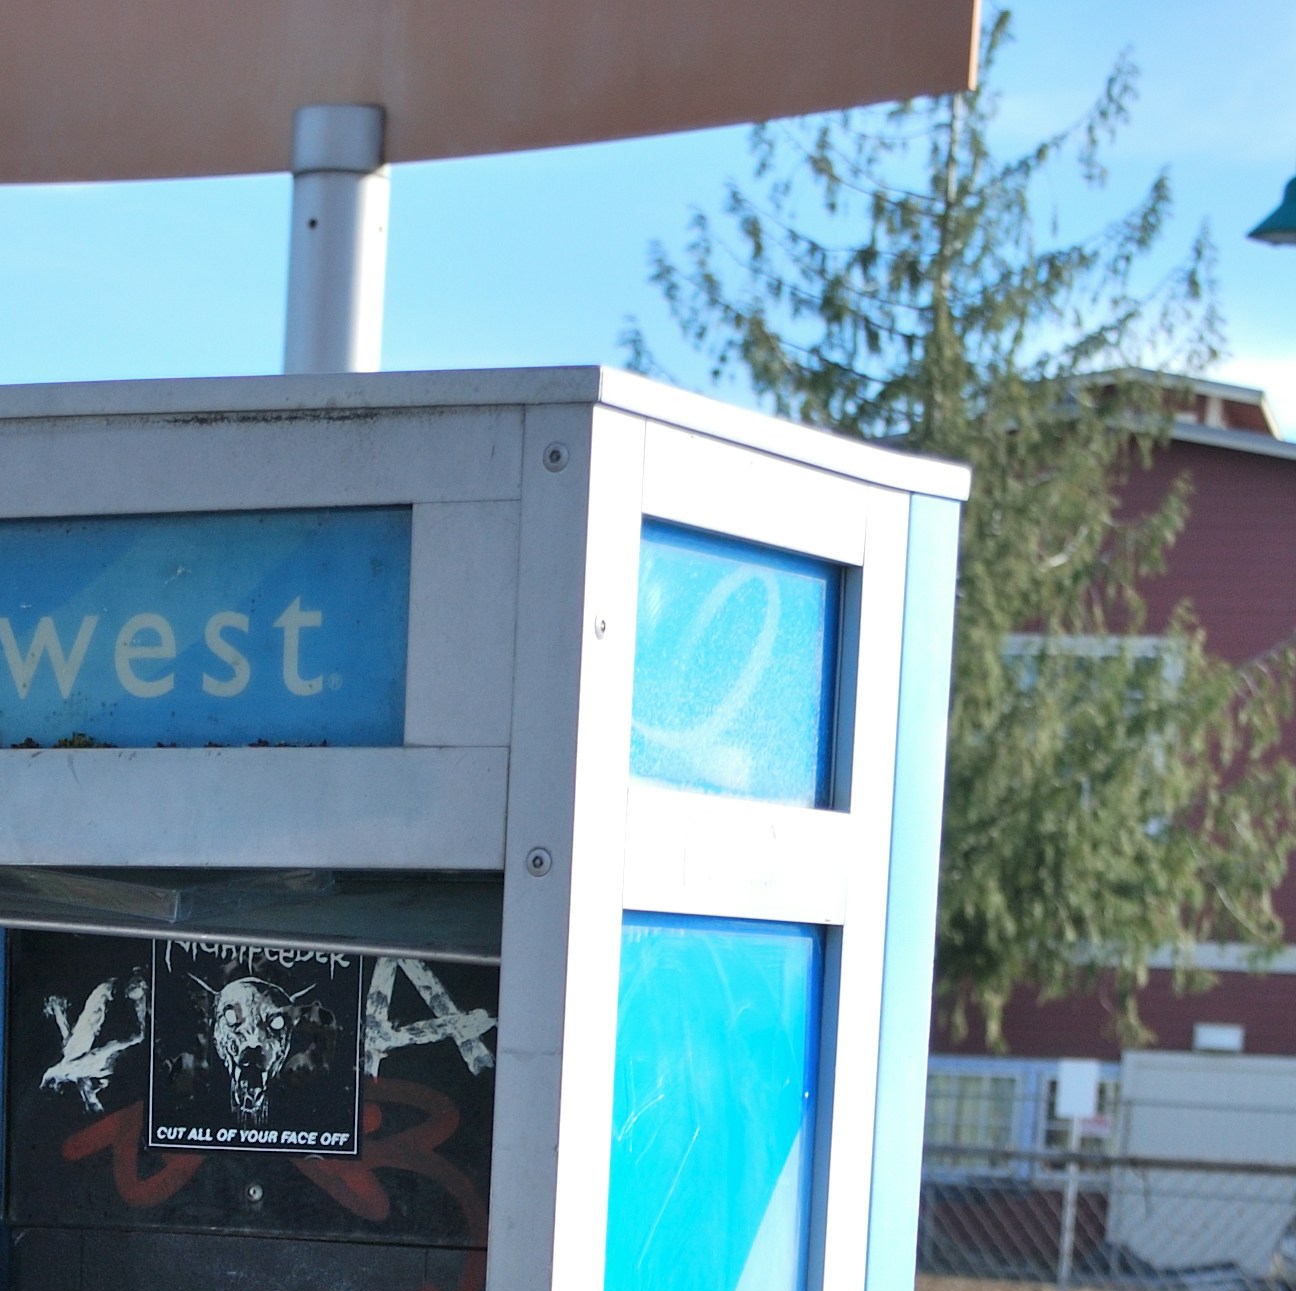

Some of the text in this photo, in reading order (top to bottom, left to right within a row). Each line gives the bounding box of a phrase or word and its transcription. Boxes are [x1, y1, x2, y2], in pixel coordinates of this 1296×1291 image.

[156, 1126, 350, 1146] CUT ALL OF YOUR FACE OFF
